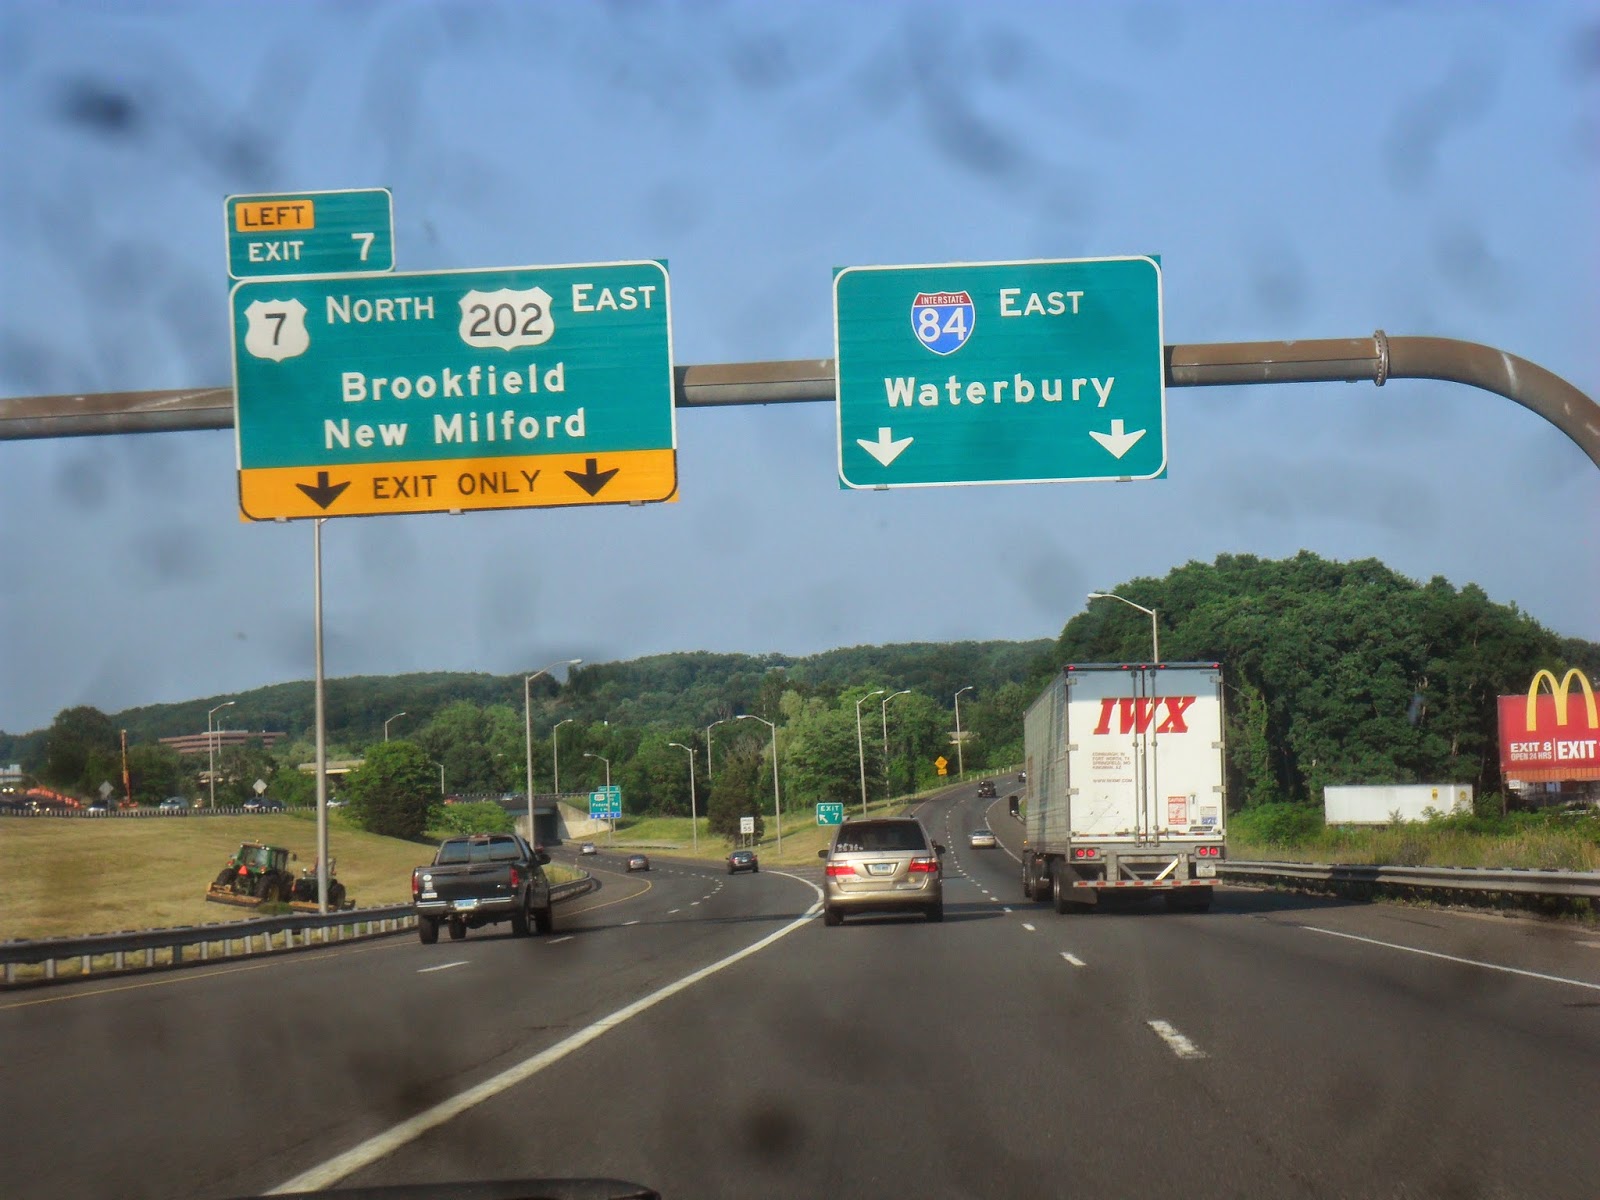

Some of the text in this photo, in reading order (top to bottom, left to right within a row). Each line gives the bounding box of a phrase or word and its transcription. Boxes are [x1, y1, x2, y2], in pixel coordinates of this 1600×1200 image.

[243, 205, 305, 227] LEFT
[248, 233, 374, 262] EXIT 7
[326, 295, 434, 324] NORTH
[572, 283, 656, 312] EAST
[921, 295, 964, 305] INTERSTATE
[999, 288, 1084, 317] EAST
[265, 312, 287, 346] 7
[469, 302, 544, 337] 202
[918, 308, 967, 343] 84
[342, 362, 565, 402] Brookfield
[885, 373, 1114, 408] Waterbury
[324, 407, 586, 449] New Milford
[373, 470, 541, 499] EXIT ONLY
[1093, 696, 1198, 735] IWX
[1510, 741, 1552, 753] EXIT 8
[1511, 751, 1552, 761] OPEN 24 HRS
[1557, 740, 1597, 760] EXIT
[832, 812, 840, 821] 7
